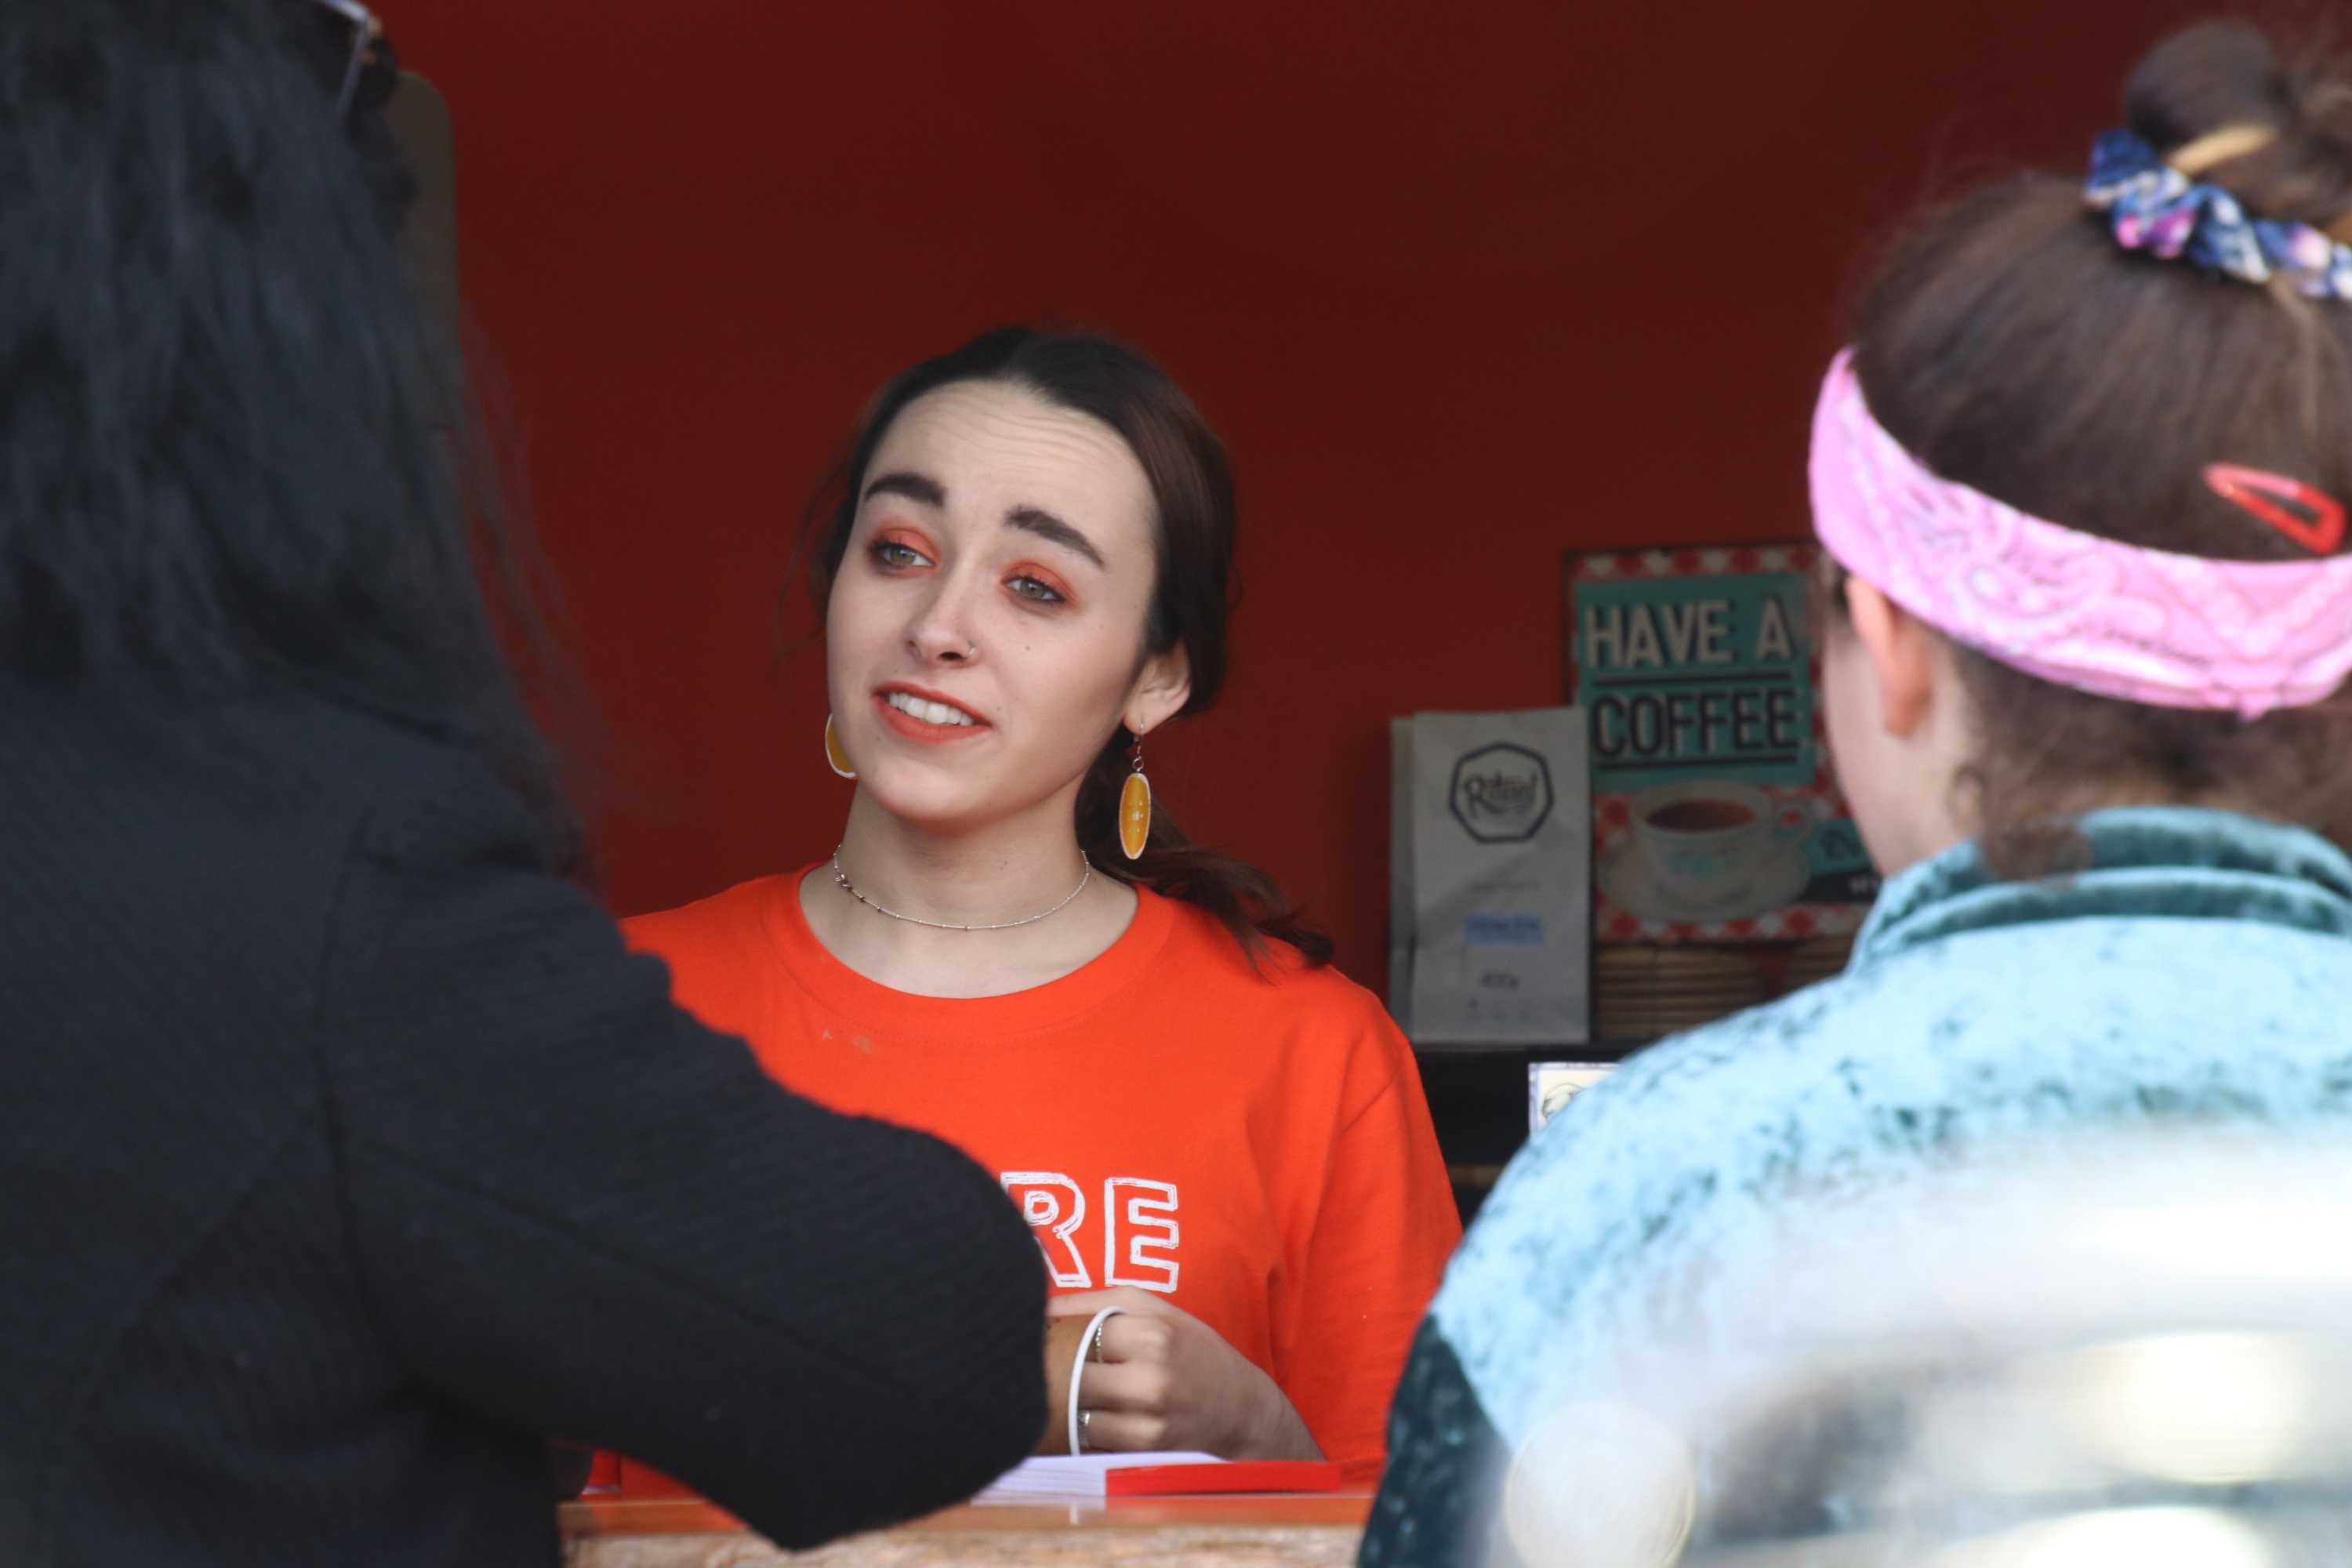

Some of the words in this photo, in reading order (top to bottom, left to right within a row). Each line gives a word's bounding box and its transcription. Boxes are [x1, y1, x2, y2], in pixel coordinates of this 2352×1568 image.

[1584, 598, 1736, 667] HAVE
[1755, 596, 1795, 659] A
[1592, 687, 1801, 755] COFFEE
